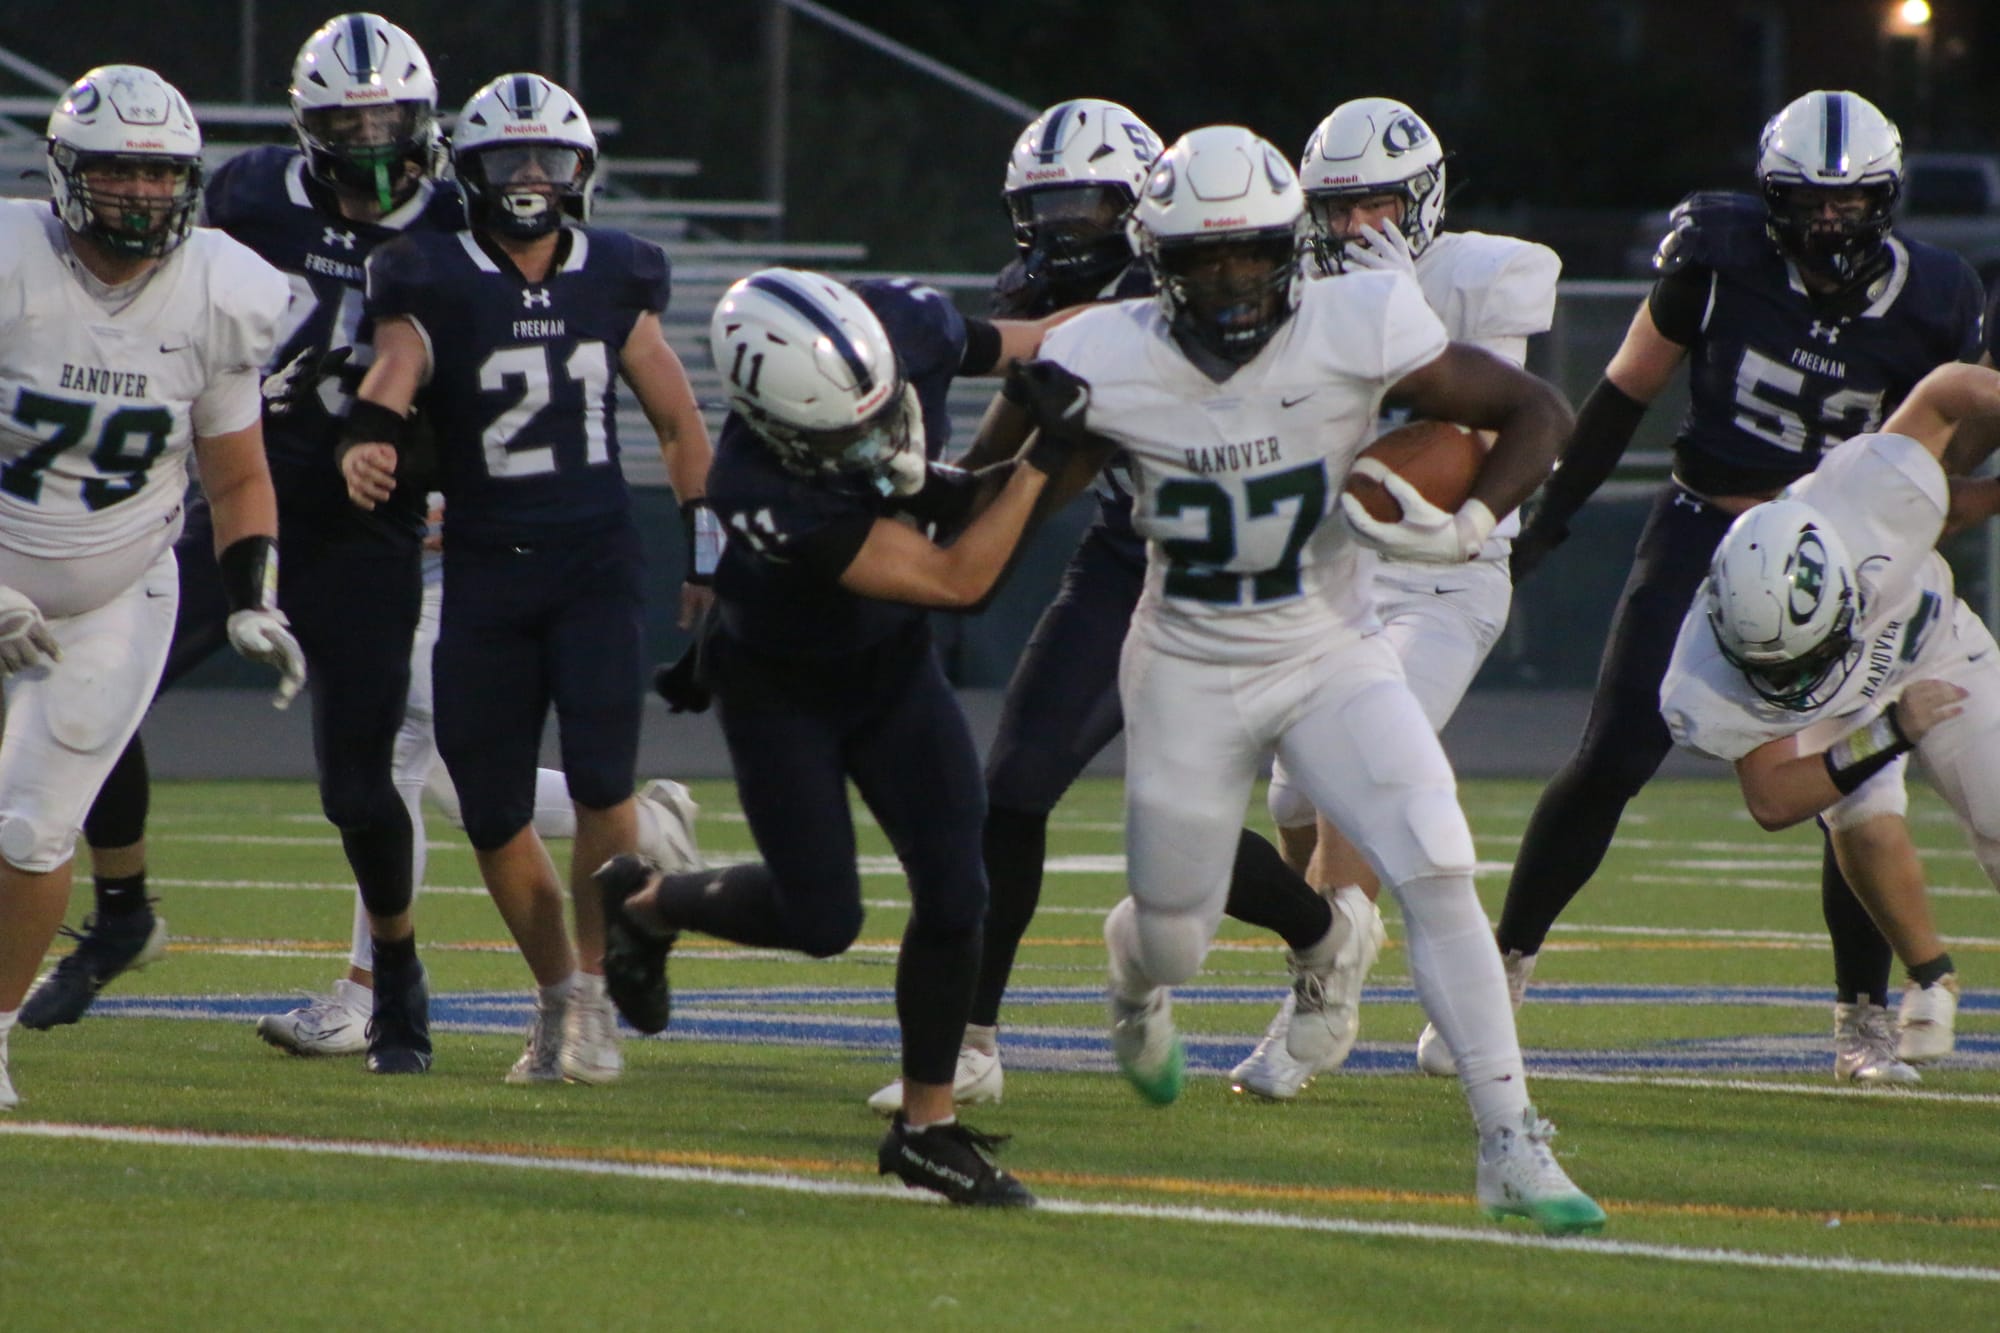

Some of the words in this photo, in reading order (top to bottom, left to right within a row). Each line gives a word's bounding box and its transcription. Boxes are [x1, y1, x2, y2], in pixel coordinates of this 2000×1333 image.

[1322, 175, 1358, 185] Riddell
[512, 319, 565, 338] FREEMAN
[59, 363, 148, 399] HANOVER
[730, 342, 764, 398] 11
[1792, 348, 1846, 379] FREEMAN
[479, 340, 611, 478] 21
[0, 386, 174, 513] 79
[1184, 436, 1282, 473] HANOVER
[1154, 457, 1328, 607] 27
[1859, 620, 1903, 699] HANOVER
